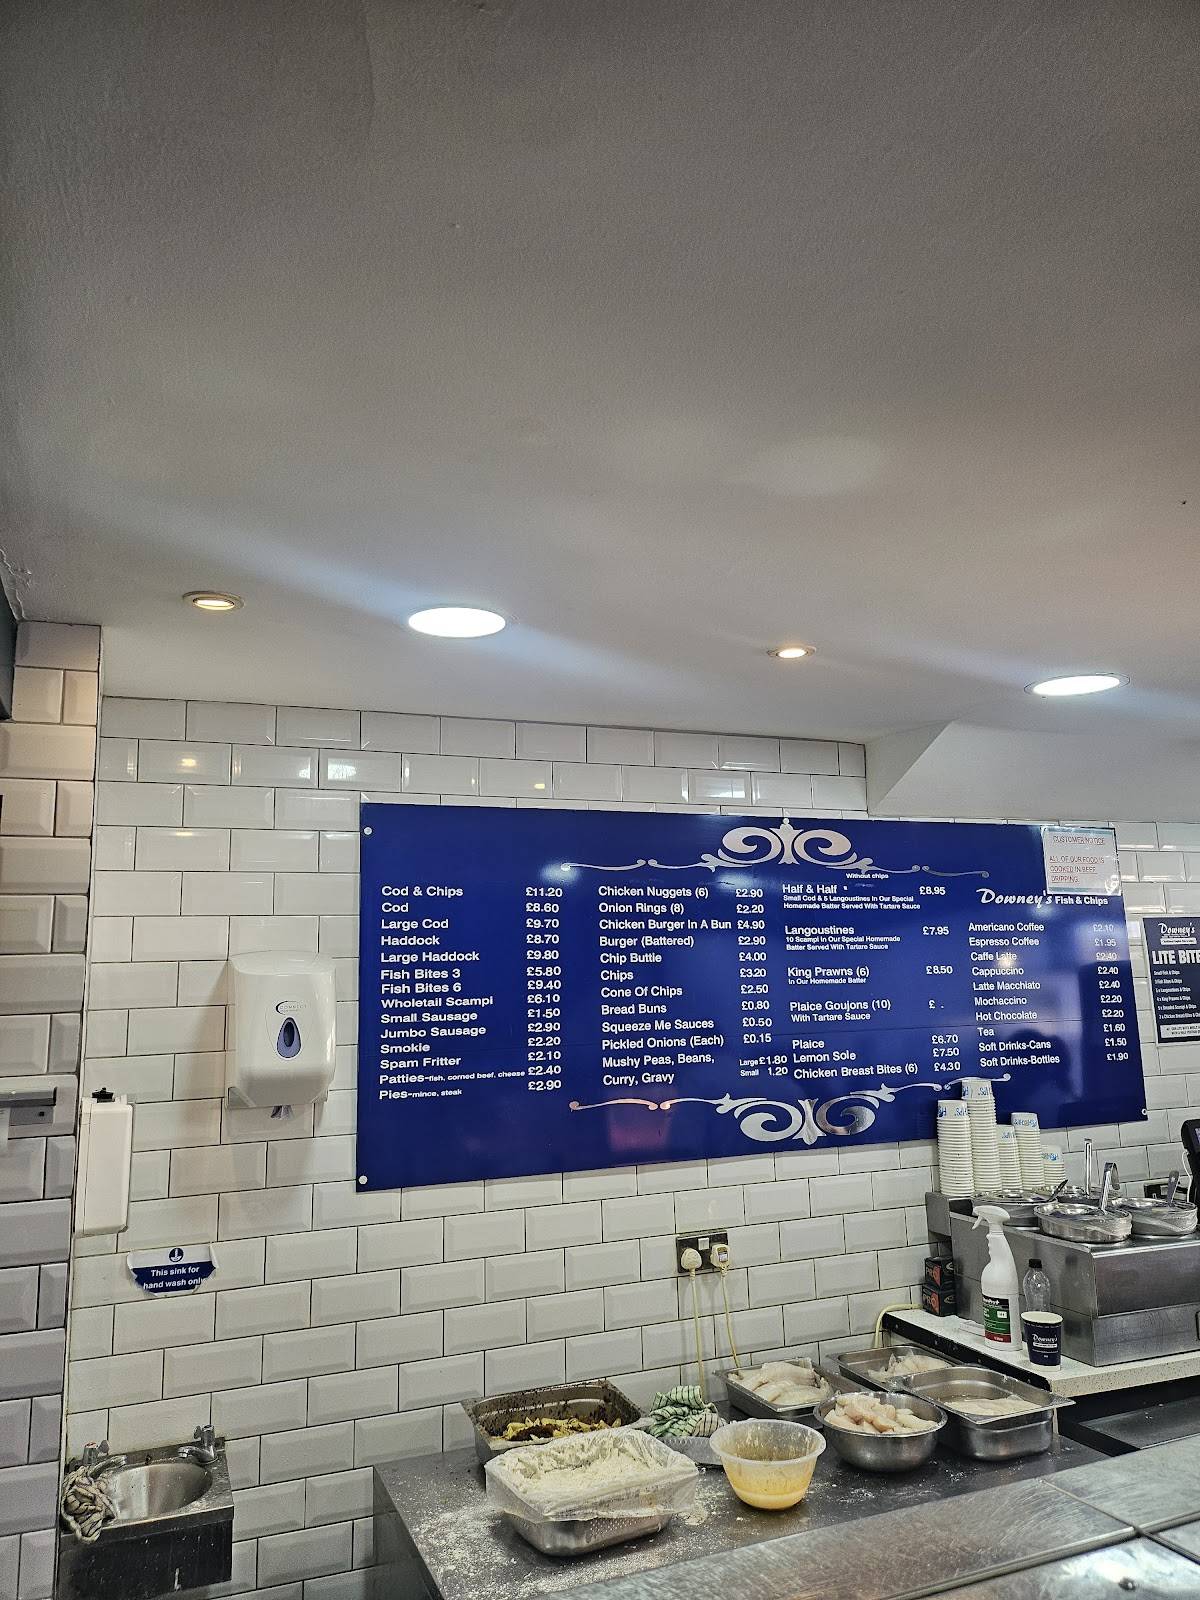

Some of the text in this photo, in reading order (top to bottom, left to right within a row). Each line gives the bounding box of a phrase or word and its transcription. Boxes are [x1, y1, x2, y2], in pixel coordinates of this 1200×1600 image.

[381, 886, 562, 898] Cod & Chips £11.20
[599, 886, 763, 898] Chicken Nuggets (6) £2.90
[782, 884, 945, 895] Half & Half £8.95
[976, 888, 1052, 908] Downey's
[1055, 897, 1074, 905] Fish
[1084, 897, 1108, 906] Chips
[381, 902, 559, 913] Cod £8.60
[599, 903, 764, 914] Onion Rings (8) £2.20
[381, 919, 559, 931] Large Cod £9.70
[600, 919, 765, 931] Chicken Burger In A Bun £4.90
[785, 926, 949, 936] Langoustines £7.95
[968, 923, 1044, 931] Americano Coffee
[1158, 922, 1194, 936] Downey's
[381, 935, 559, 946] Haddock £8.70
[969, 938, 1116, 948] Espresso Coffee £1.95
[600, 953, 766, 964] Chip Buttie £4.00
[971, 952, 994, 961] Caffe
[1152, 950, 1176, 964] LITE
[381, 966, 561, 979] Fish Bites 3 £5.80
[788, 966, 953, 978] King Prawns (6) £8.50
[972, 967, 1118, 977] Cappuccino £2.40
[601, 985, 768, 998] Cone Of Chips £2.50
[381, 994, 560, 1008] Wholetail Scampi £6.10
[790, 999, 891, 1012] Plaice Goujons (10)
[975, 995, 1122, 1006] Mochaccino £2.20
[791, 1012, 870, 1022] With Tartare Sauce
[976, 1010, 1124, 1021] Hot Chocolate £2.20
[381, 1023, 560, 1039] Jumbo Sausage £2.90
[602, 1017, 772, 1033] Squeeze Me Sauces £0.50
[977, 1024, 1125, 1036] Tea £1.60
[602, 1033, 771, 1050] Pickled Onions (Each) £0.15
[792, 1035, 958, 1049] Plaice £6.70
[380, 1051, 561, 1070] Spam Fritter £2.10
[603, 1056, 640, 1069] Mushy
[644, 1055, 674, 1066] Peas,
[678, 1054, 715, 1064] Beans,
[759, 1056, 787, 1065] £1.80
[980, 1052, 1128, 1067] Soft Drinks-Bottles £1.90
[528, 1065, 561, 1075] £2.40
[794, 1062, 960, 1079] Chicken Breast Bites (6) £4.30
[603, 1074, 638, 1086] Curry,
[642, 1072, 674, 1084] Gravy
[768, 1067, 788, 1075] 1.20
[528, 1080, 561, 1090] £2.90
